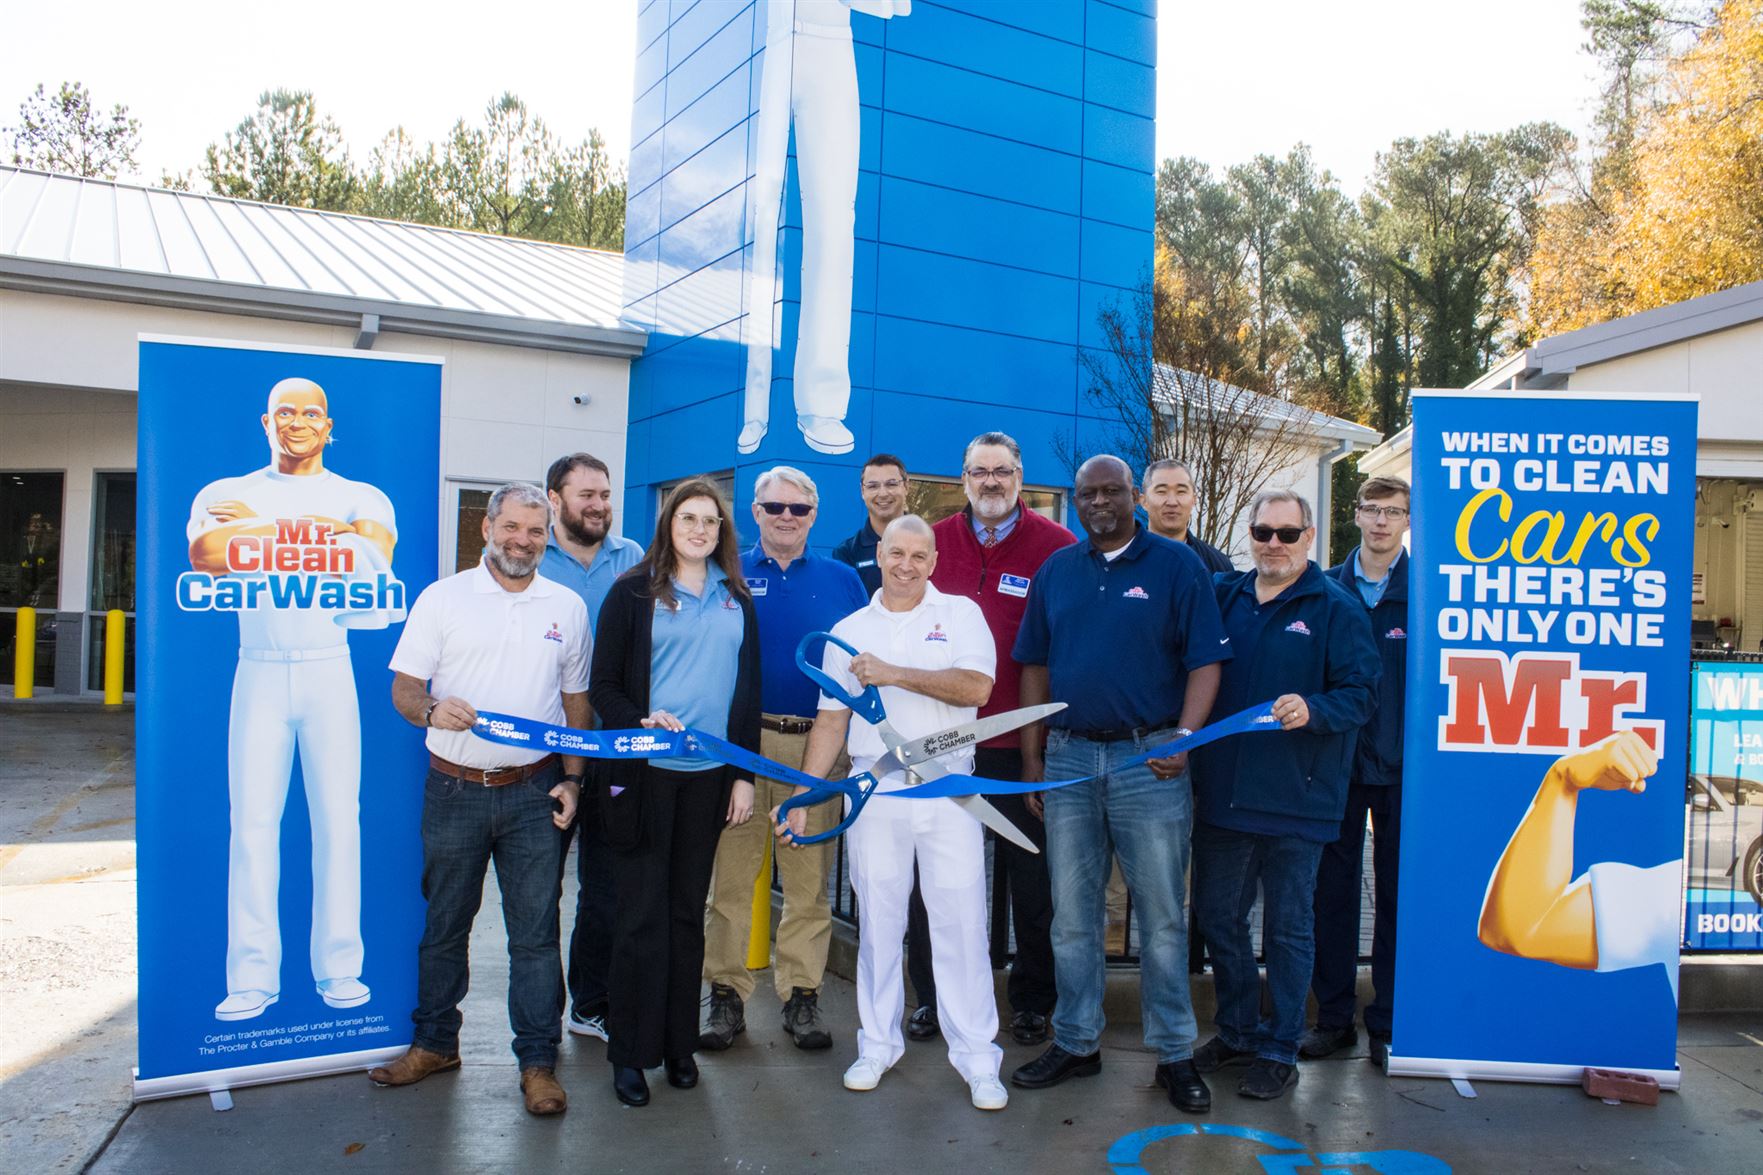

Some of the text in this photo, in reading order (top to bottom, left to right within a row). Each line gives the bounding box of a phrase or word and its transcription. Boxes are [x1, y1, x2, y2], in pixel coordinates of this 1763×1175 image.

[1442, 432, 1670, 457] WHEN IT COMES
[1441, 458, 1669, 495] TO CLEAN
[275, 518, 337, 546] Mr.
[1455, 487, 1660, 567] Cars
[228, 536, 354, 573] Clean
[178, 573, 404, 610] CarWash
[1439, 564, 1666, 608] THERE'S
[1438, 608, 1665, 647] ONLY ONE
[489, 729, 530, 742] CHAMBER
[490, 720, 515, 731] COBB
[937, 730, 959, 743] COBB
[560, 734, 584, 743] COBB
[560, 740, 600, 752] CHAMBER
[631, 736, 655, 744] COBB
[631, 742, 671, 752] CHAMBER
[939, 733, 976, 751] CHAMBER
[1698, 913, 1763, 933] BOOK
[199, 1024, 392, 1056] The Procter & Gamble Company or its affiliates.
[204, 1014, 384, 1044] Certain trademarks used under license from
